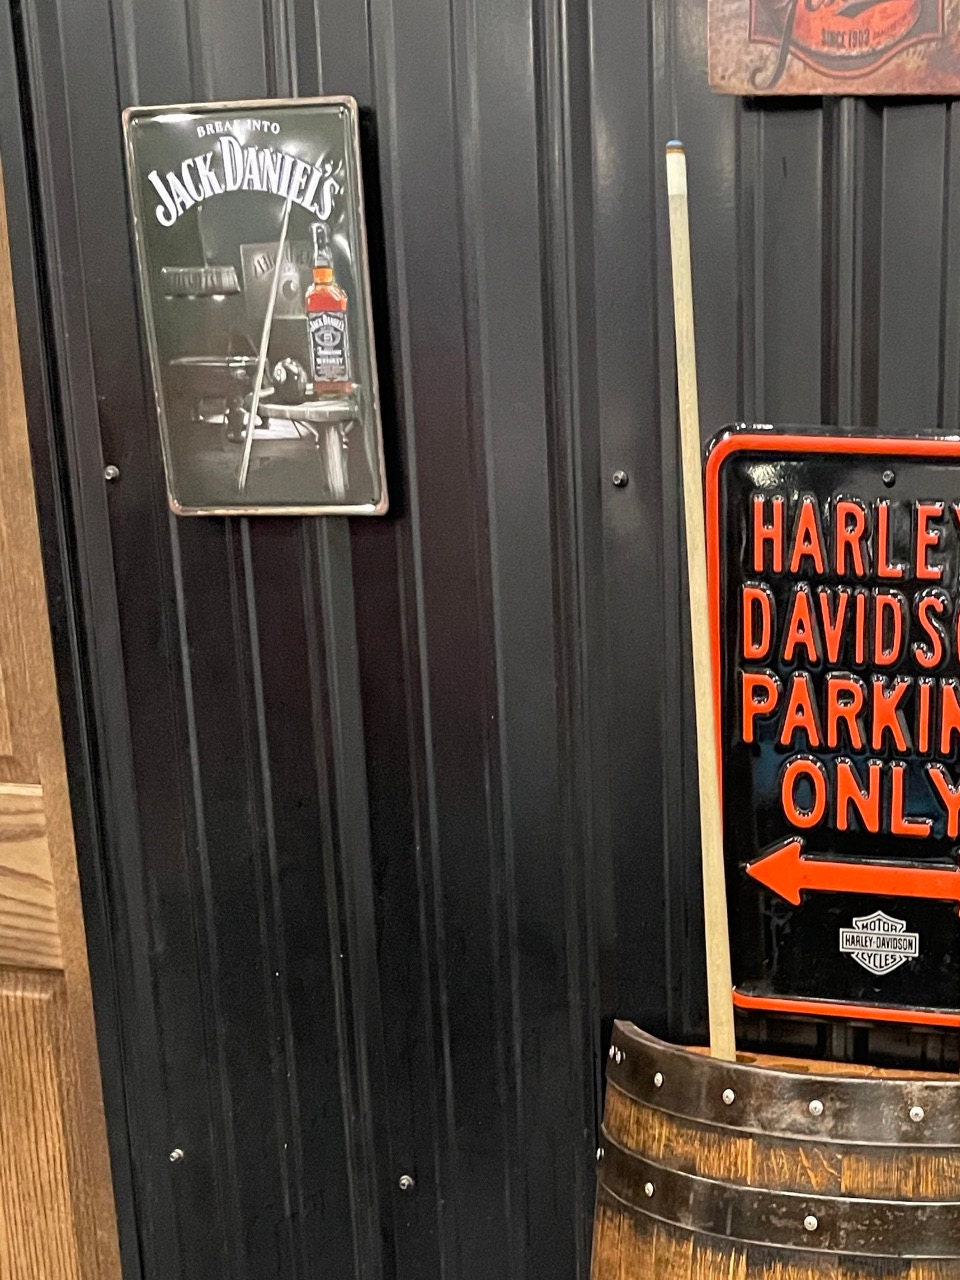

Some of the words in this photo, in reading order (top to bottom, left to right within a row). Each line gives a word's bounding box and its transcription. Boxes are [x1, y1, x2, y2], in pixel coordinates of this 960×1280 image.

[247, 119, 281, 135] INTO
[148, 152, 226, 227] JACK
[218, 136, 340, 221] DANIEL'S
[861, 919, 898, 933] MOTOR
[845, 934, 914, 951] HARLEY-DAVIDSON
[861, 952, 897, 969] CYCLES
